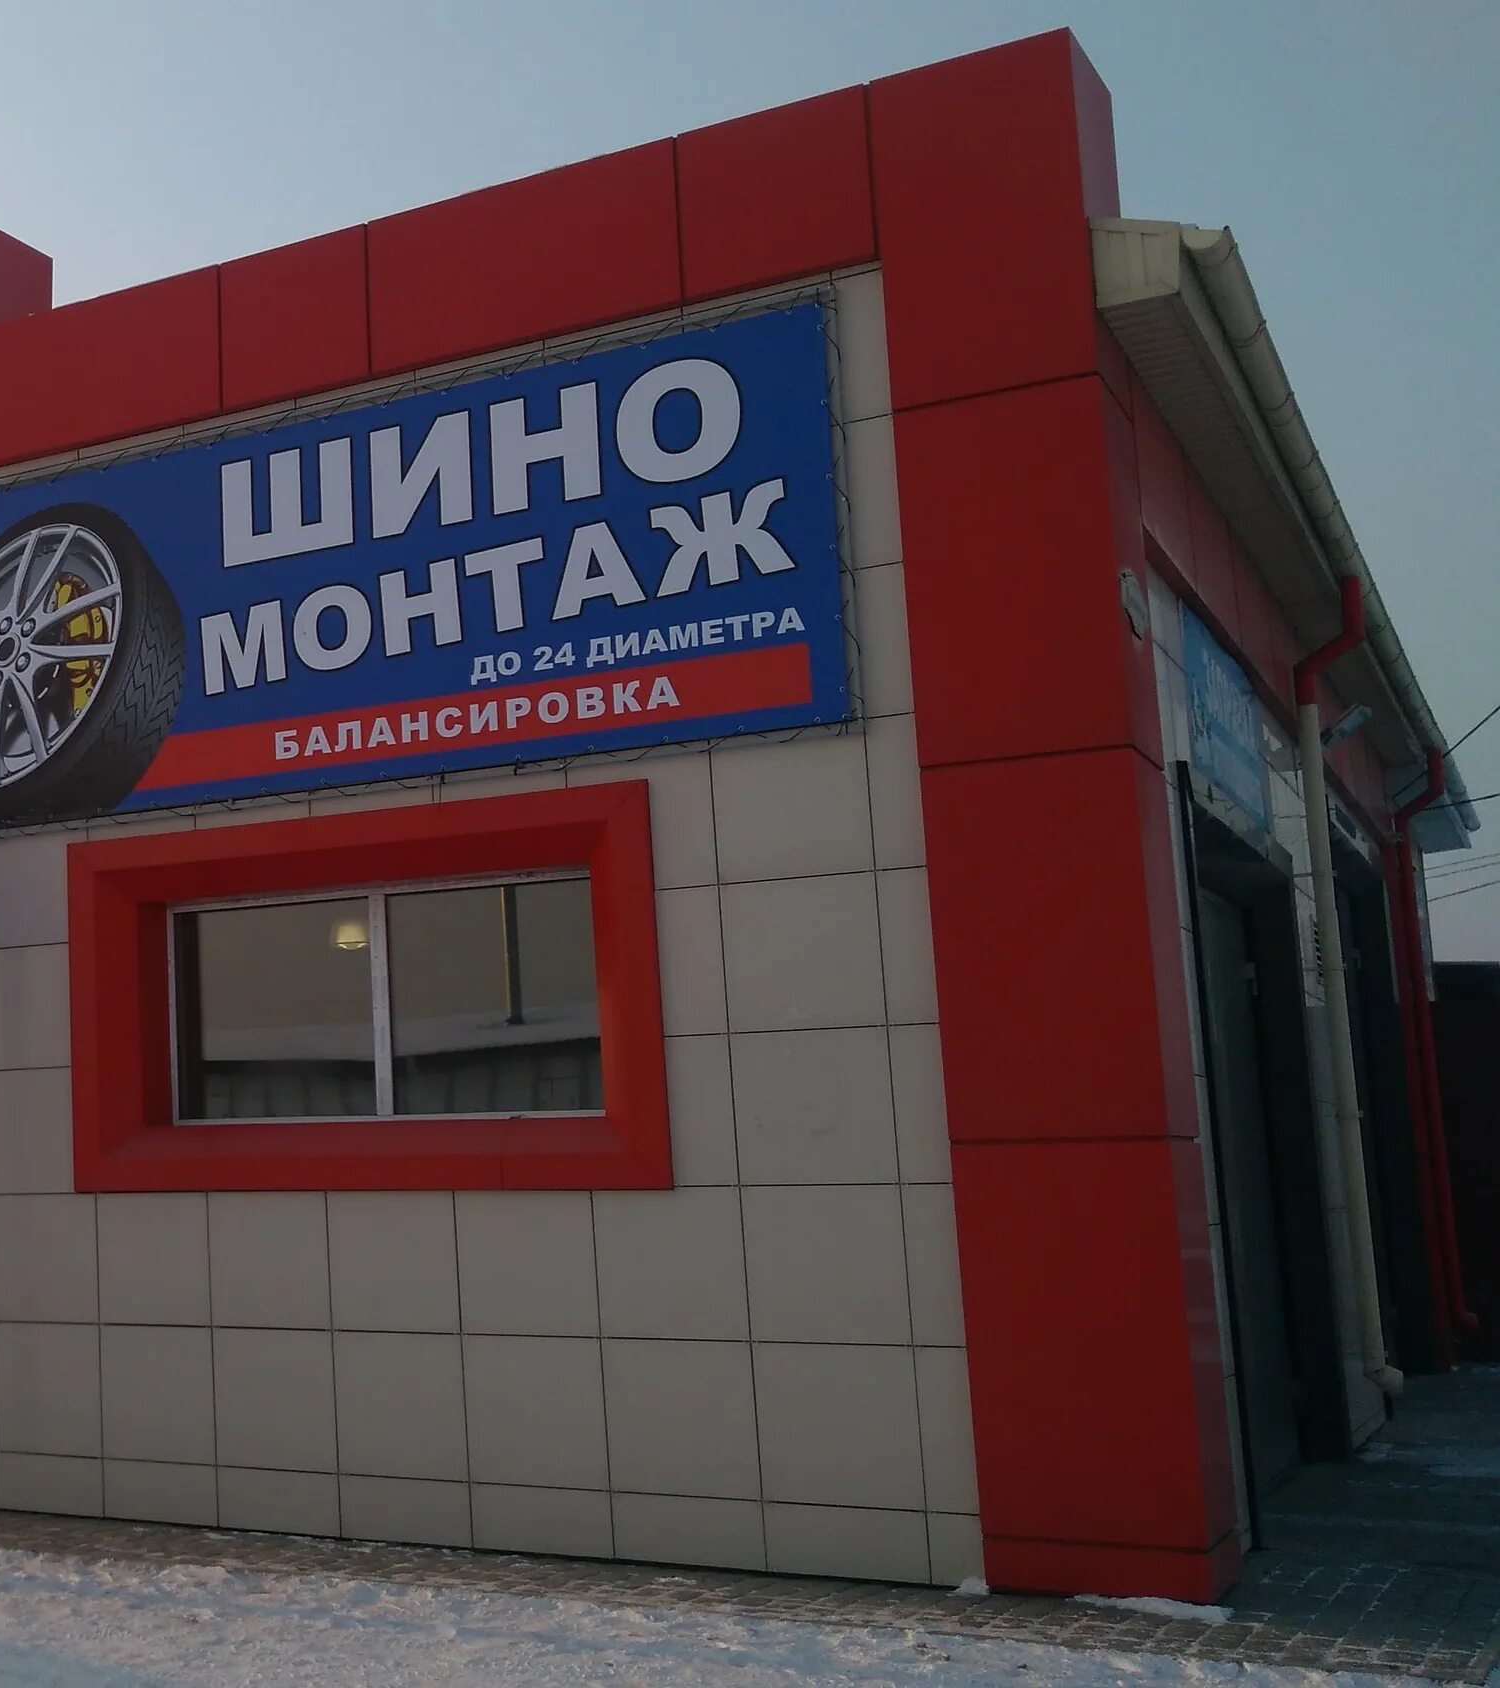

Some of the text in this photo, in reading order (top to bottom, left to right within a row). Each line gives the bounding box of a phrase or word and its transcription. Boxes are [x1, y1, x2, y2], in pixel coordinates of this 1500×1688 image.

[219, 357, 742, 568] ШИНО
[199, 477, 797, 698] МОНТАЖ
[470, 606, 806, 685] ДО 24 ДИАМЕТРА
[273, 675, 681, 761] БАЛАНСИРОВКА
